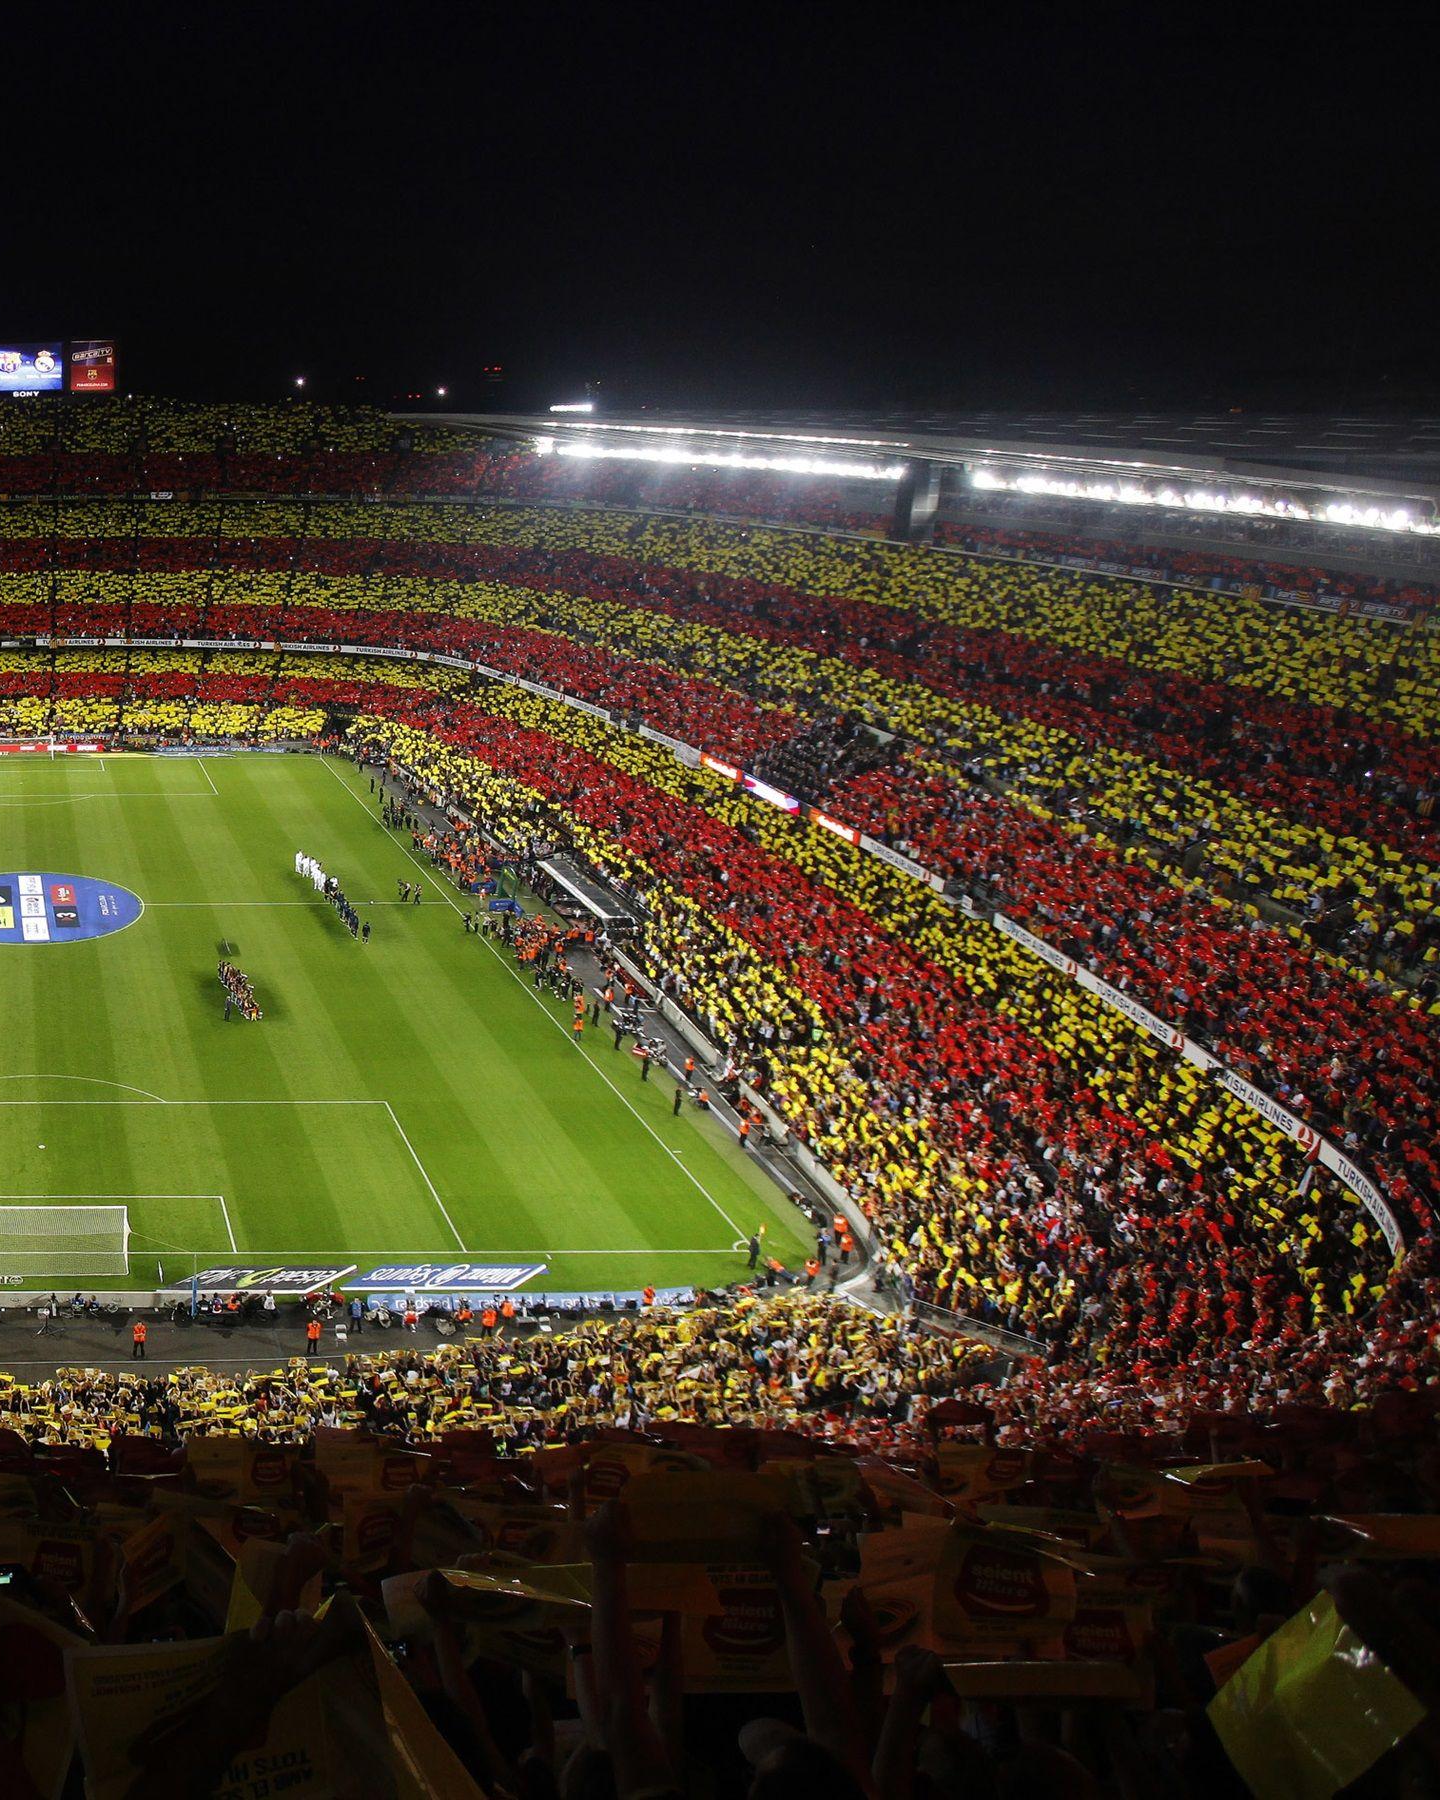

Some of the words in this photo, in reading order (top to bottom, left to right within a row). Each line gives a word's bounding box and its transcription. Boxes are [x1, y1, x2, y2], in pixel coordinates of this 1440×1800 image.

[1095, 981, 1130, 1013] TURKISH
[1130, 1005, 1169, 1040] AIRLINES
[1247, 1091, 1294, 1132] AIRLINES
[1336, 1159, 1373, 1201] TURKISH
[457, 1267, 531, 1285] Allianz
